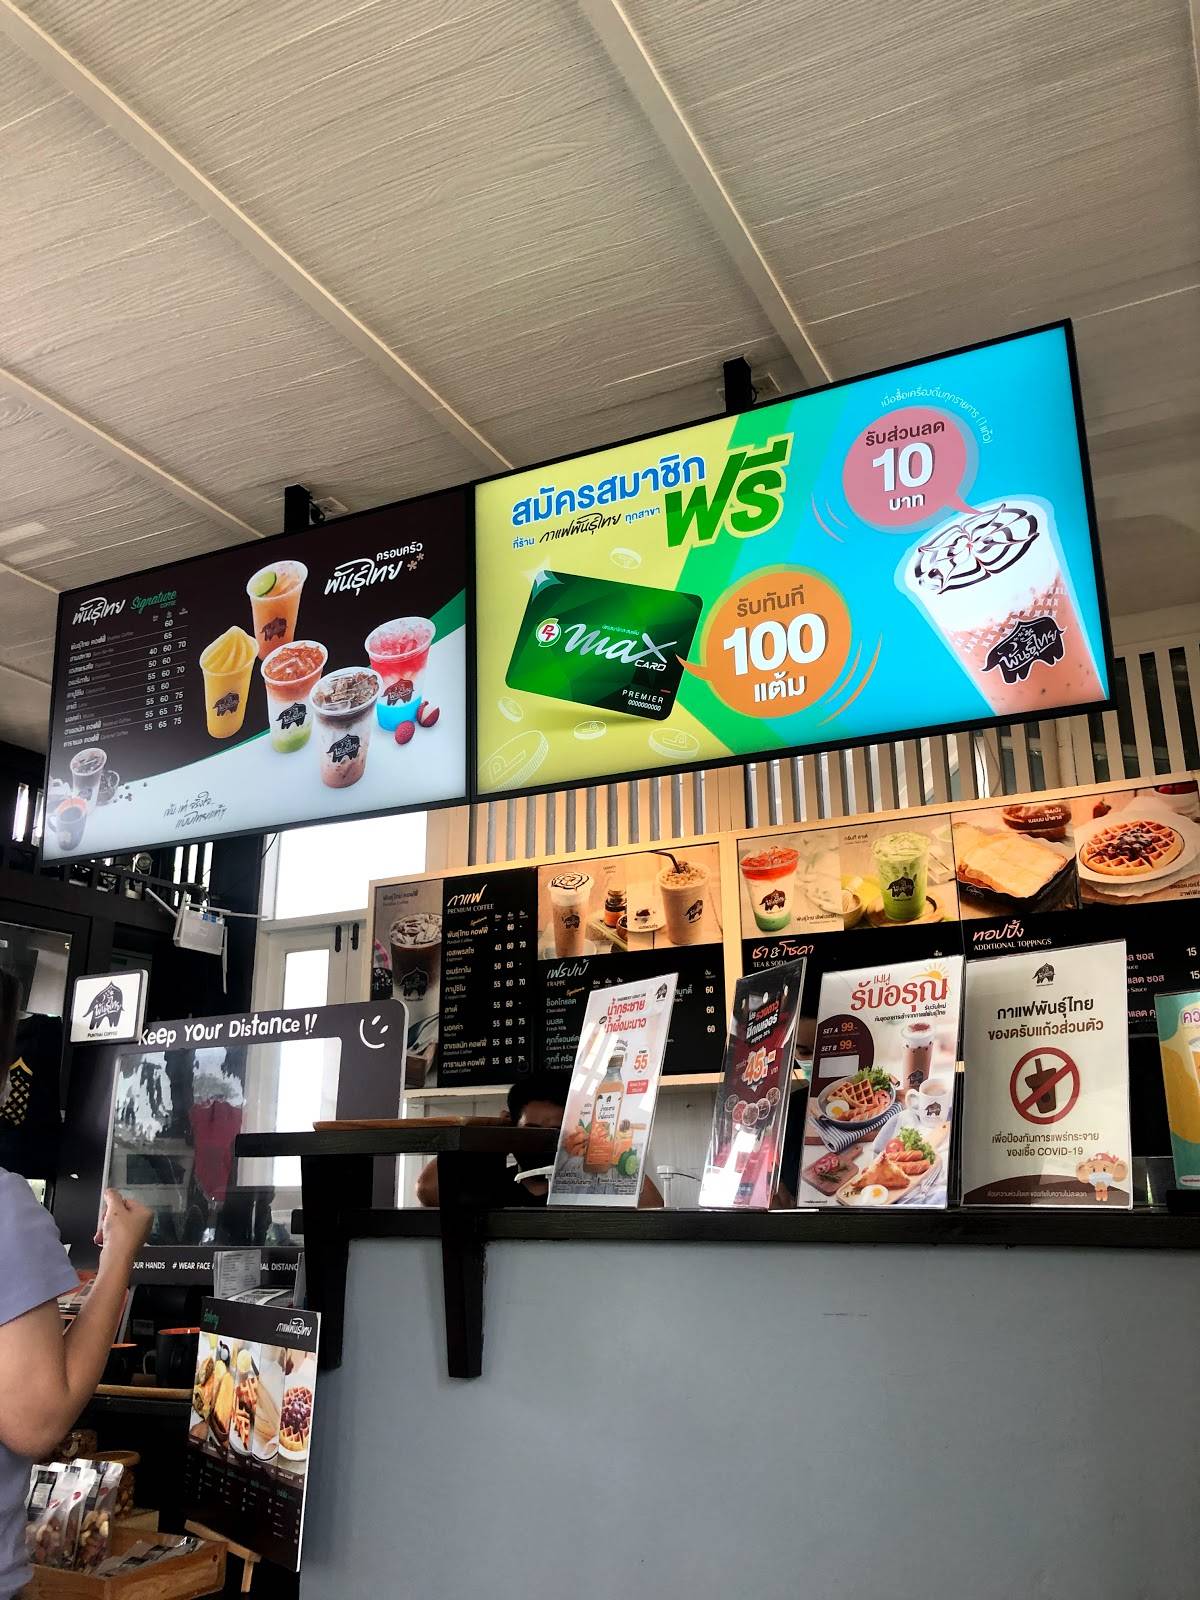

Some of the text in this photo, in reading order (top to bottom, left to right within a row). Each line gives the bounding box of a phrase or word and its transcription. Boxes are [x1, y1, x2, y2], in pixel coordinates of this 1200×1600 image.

[866, 419, 945, 447] รับส่วนลด
[872, 442, 933, 492] 10
[511, 454, 706, 526] สมัครสมาชิก
[663, 437, 790, 549] ฟรี
[889, 493, 925, 511] บาท
[539, 511, 622, 544] กาแฟพันธุ์ไทย
[625, 506, 661, 525] ทุกสาขา
[376, 540, 424, 562] ครอบครัว
[324, 557, 404, 596] พันธุ์ไทย
[131, 590, 177, 614] Signature
[736, 585, 805, 618] รับทันที
[72, 596, 126, 626] พันธุ์ไทย
[164, 619, 174, 627] 60
[164, 632, 173, 640] 65
[163, 644, 172, 652] 60
[723, 613, 827, 676] 100
[148, 657, 171, 668] 50 60
[634, 659, 667, 672] CARD
[148, 672, 156, 680] 55
[161, 670, 170, 678] 60
[146, 682, 170, 693] 55 60
[753, 671, 805, 704] แต้ม
[146, 697, 154, 706] 55
[175, 691, 184, 699] 75
[622, 689, 664, 704] PREMIER
[145, 704, 183, 718] 55 65 75
[144, 723, 153, 731] 55
[174, 717, 182, 725] 75
[446, 883, 488, 907] กาแฟ
[447, 903, 494, 915] PREMIUM COFFEE
[973, 919, 1025, 942] ทอปปิ้ง
[506, 942, 514, 950] 60
[779, 940, 814, 957] โซดา
[973, 938, 1052, 951] ADDITIONAL TOPPINGS
[1186, 946, 1197, 956] 15
[1136, 952, 1155, 961] ซอส
[1146, 974, 1165, 983] ซอส
[1190, 970, 1200, 980] 15
[493, 978, 526, 988] 55 60 70
[705, 986, 713, 994] 60
[850, 977, 948, 1012] รับอรุณ
[493, 1001, 501, 1009] 55
[608, 998, 646, 1016] น้ำกระชาย
[706, 1006, 715, 1014] 60
[997, 996, 1094, 1020] กาแฟพันธุ์ไทย
[492, 1020, 500, 1028] 55
[505, 1018, 513, 1026] 60
[707, 1025, 716, 1033] 60
[841, 1022, 858, 1032] 99.-
[988, 1018, 1104, 1041] ของดรับแก้วส่วนตัว
[138, 1024, 176, 1048] Keep
[492, 1038, 500, 1046] 55
[839, 1040, 856, 1050] 99.-
[492, 1057, 500, 1065] 55
[505, 1056, 512, 1064] 65
[634, 1054, 648, 1070] 55
[992, 1131, 1100, 1144] เพื่อป้องกันการแพร่กระจาย
[1006, 1144, 1084, 1157] ของเชื้อ COVID-19
[145, 1261, 166, 1270] HANDS
[178, 1261, 196, 1270] WEAR
[196, 1261, 211, 1270] FACE
[271, 1262, 299, 1271] DISTANC
